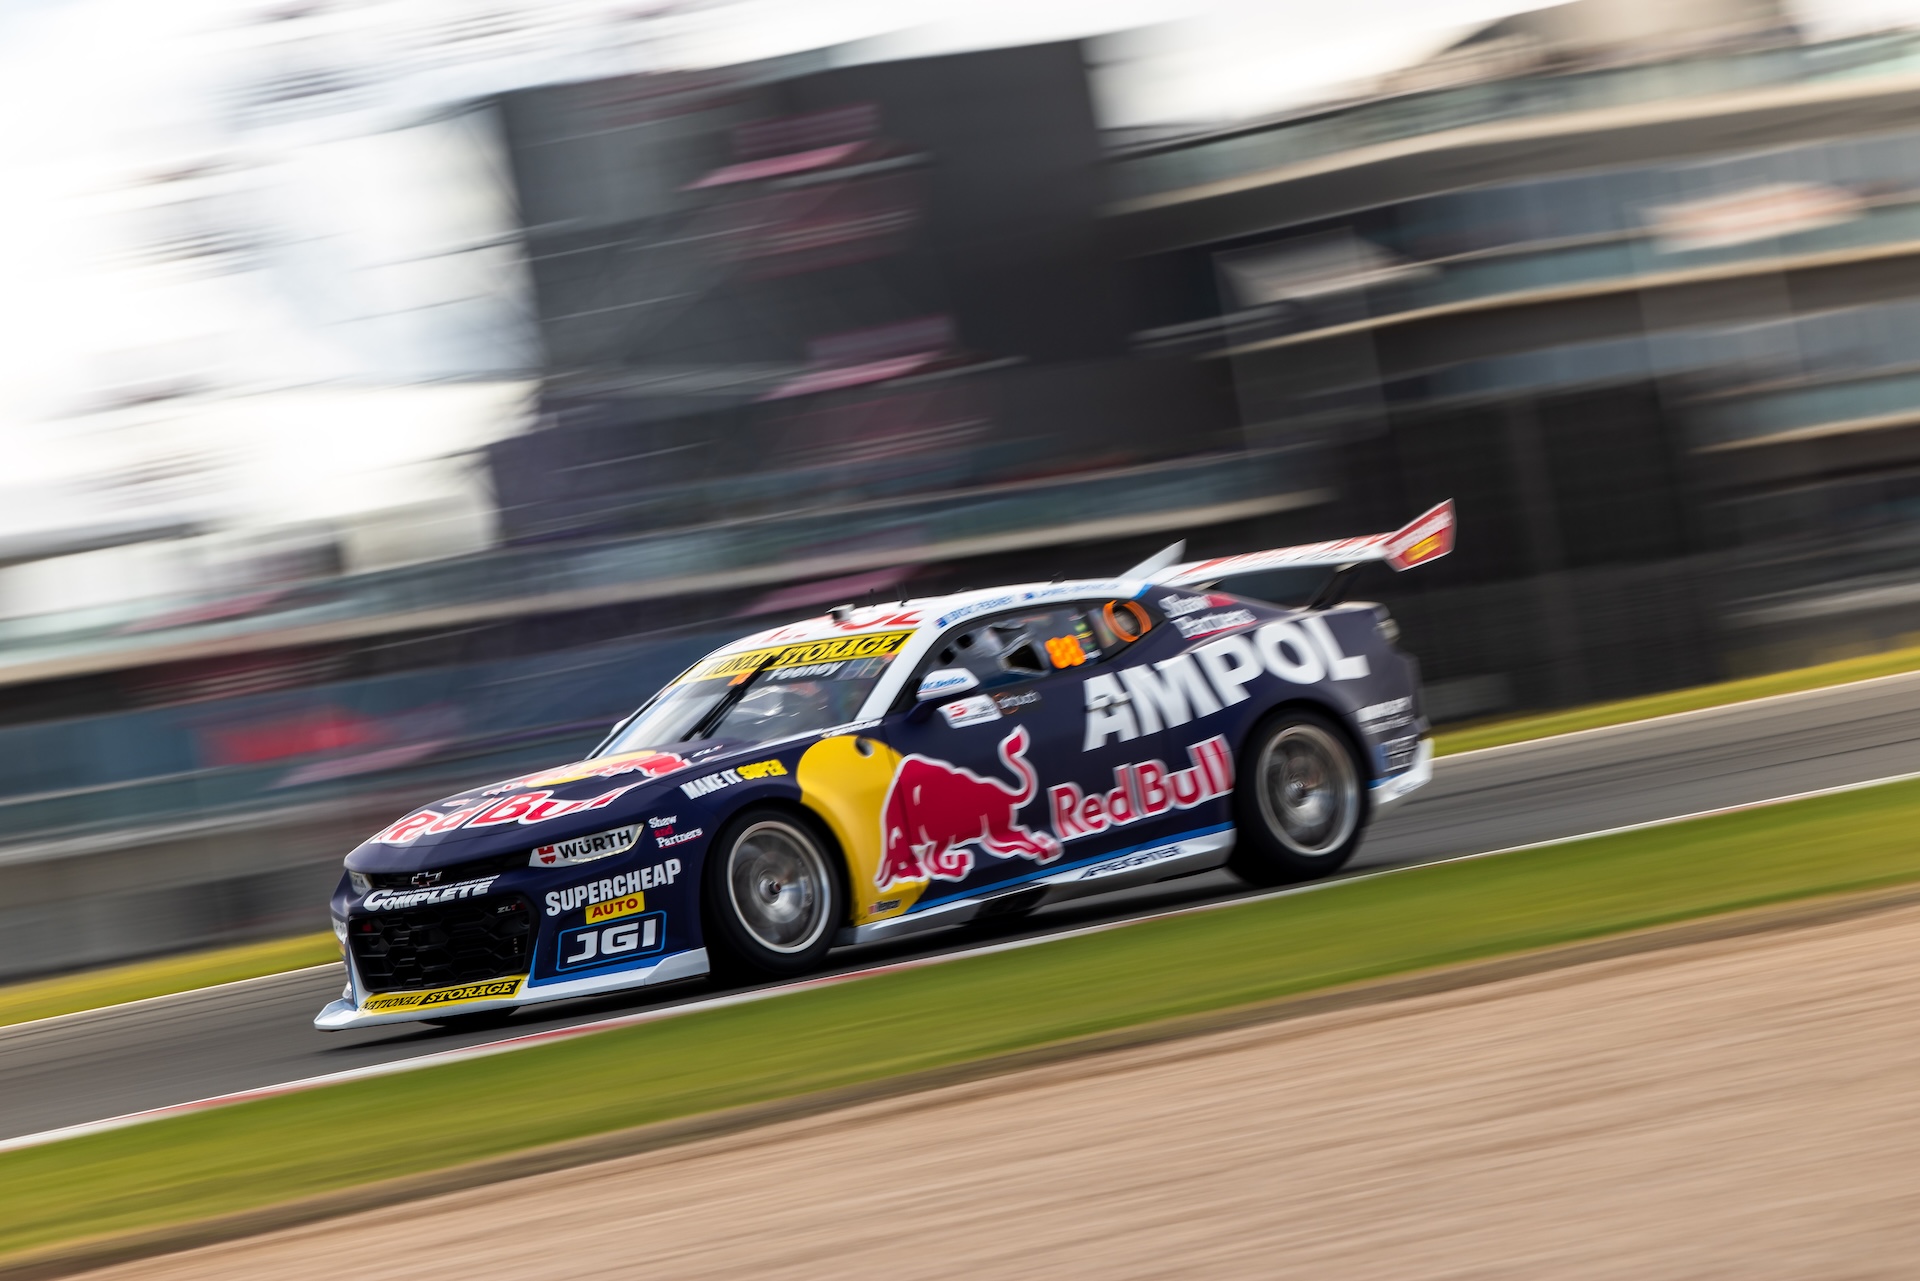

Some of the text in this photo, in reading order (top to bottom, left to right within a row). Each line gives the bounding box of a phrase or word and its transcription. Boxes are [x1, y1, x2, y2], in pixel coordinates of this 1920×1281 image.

[775, 635, 896, 666] STORAGE
[765, 662, 846, 682] Feeney
[1083, 616, 1371, 752] AMPOL
[680, 772, 729, 800] MAKE
[648, 815, 677, 829] Shaw
[656, 828, 703, 848] Partners
[363, 880, 494, 912] COMPLETE
[545, 858, 682, 917] SUPERCHEAP
[591, 898, 639, 919] AUTO
[567, 918, 657, 964] JGI
[361, 980, 516, 1012] NATIONAL STORAGE
